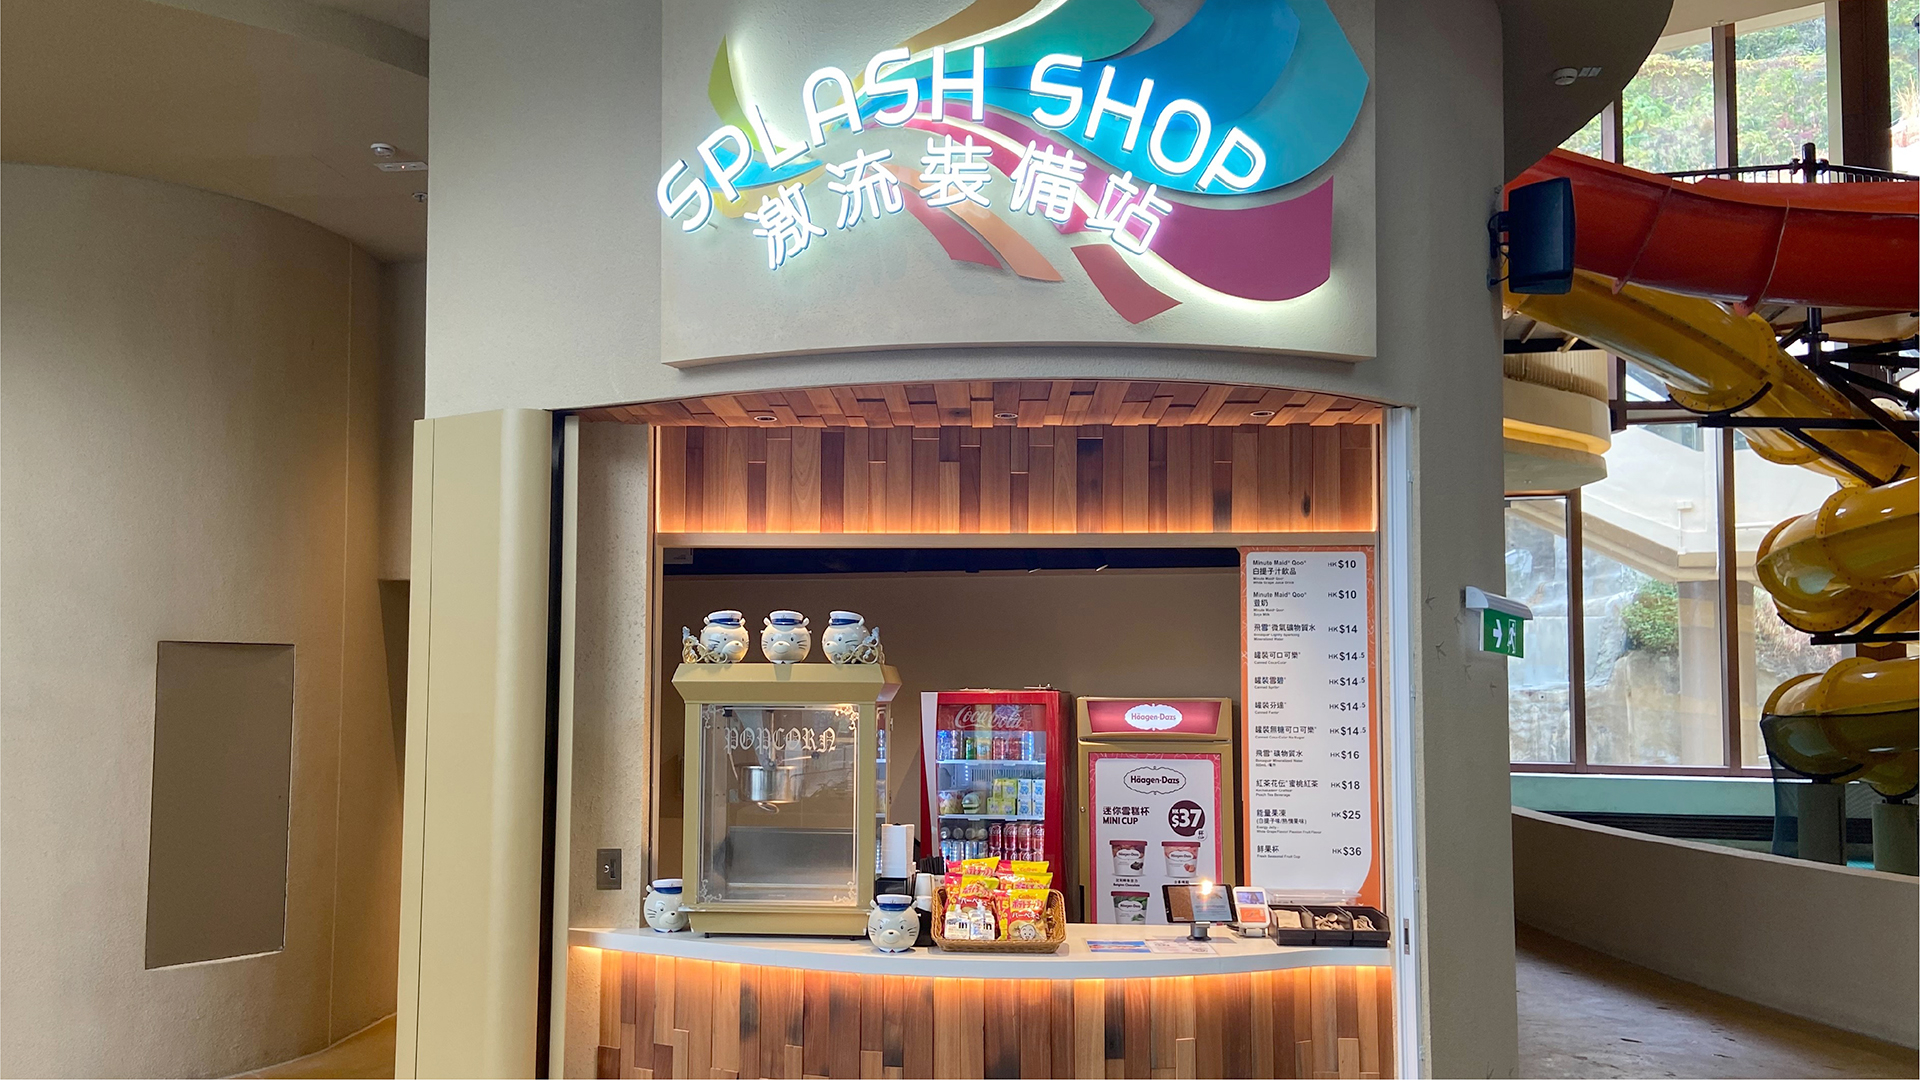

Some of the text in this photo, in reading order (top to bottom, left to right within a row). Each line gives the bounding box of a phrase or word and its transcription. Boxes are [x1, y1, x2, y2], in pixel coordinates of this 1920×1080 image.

[656, 45, 1268, 233] SPLASH SHOP
[743, 134, 1173, 271] 激流裝備站
[724, 727, 837, 754] POPCORN
[1102, 806, 1150, 816] 迷你雪糕杯
[1102, 816, 1139, 825] MINI CUP
